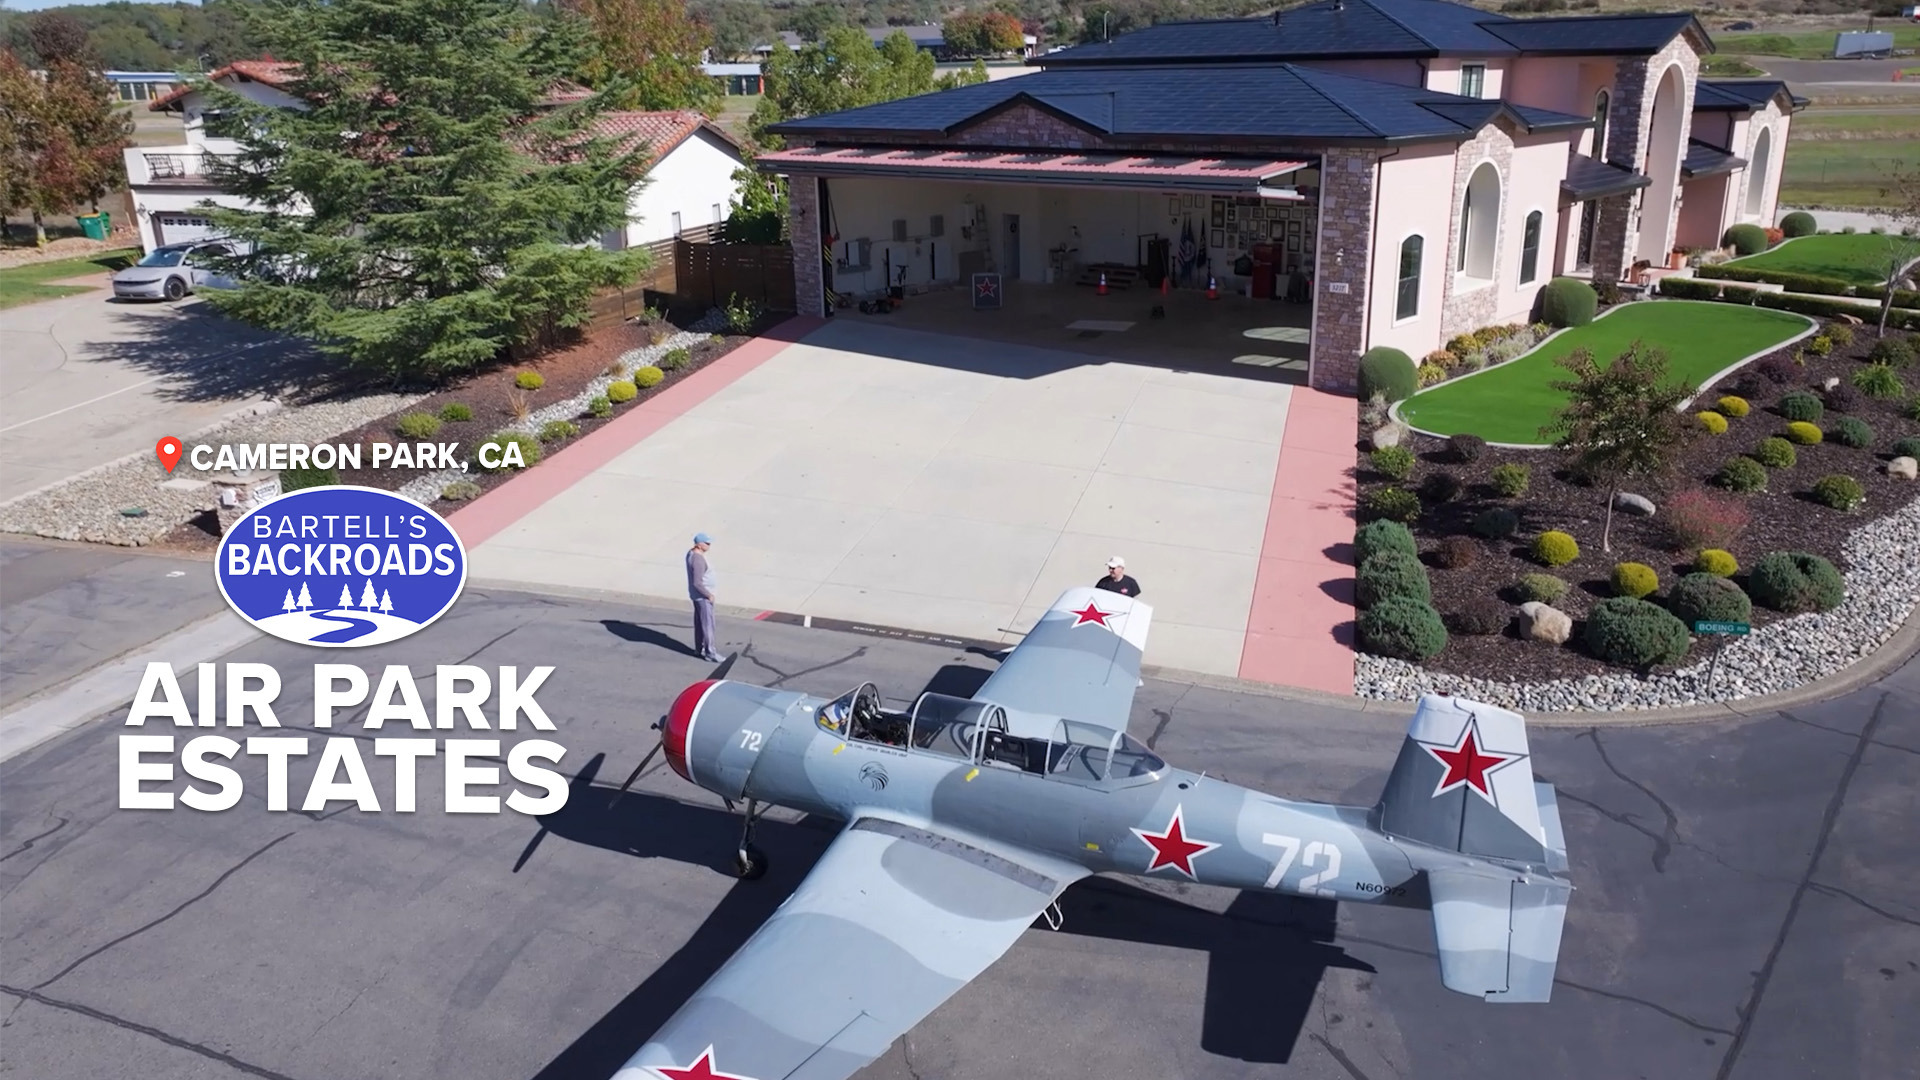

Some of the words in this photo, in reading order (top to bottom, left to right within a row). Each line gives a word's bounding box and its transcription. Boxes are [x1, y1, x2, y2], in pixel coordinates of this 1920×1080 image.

[1698, 623, 1734, 632] BOEING
[740, 729, 762, 752] 72
[1262, 832, 1342, 898] 72
[1356, 881, 1407, 896] N60972
